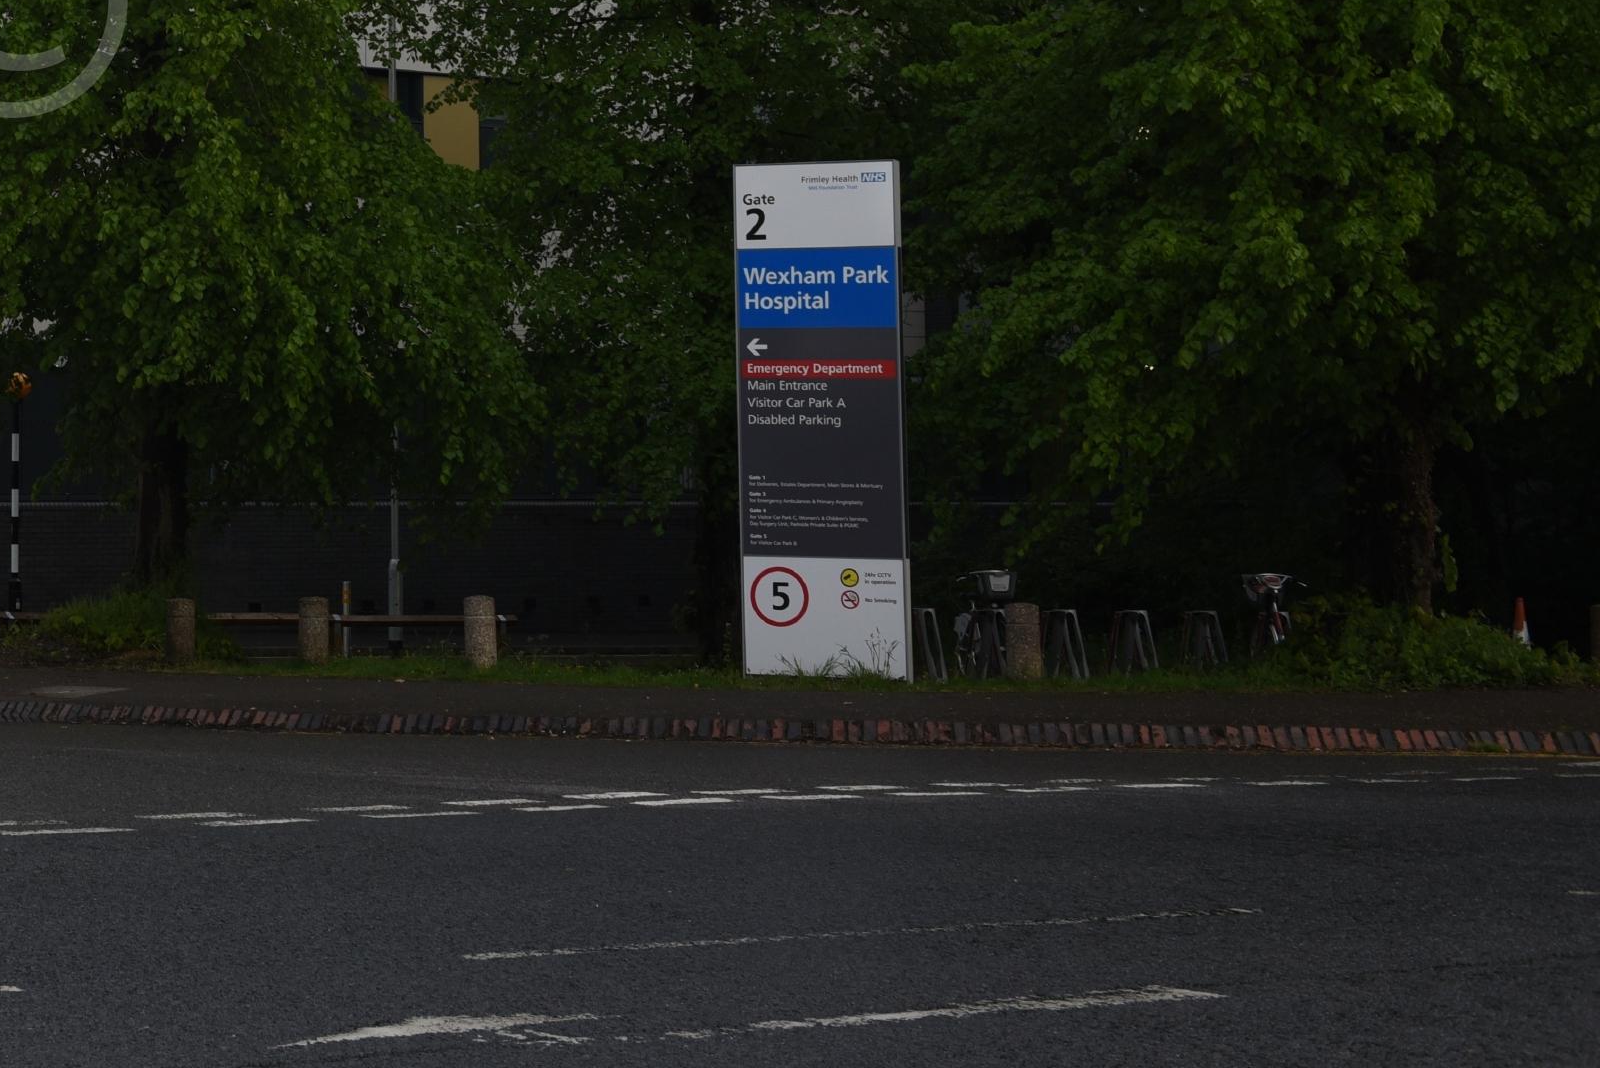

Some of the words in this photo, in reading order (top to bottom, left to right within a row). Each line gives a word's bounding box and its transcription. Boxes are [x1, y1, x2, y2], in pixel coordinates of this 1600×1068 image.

[801, 175, 830, 185] Frimley
[832, 174, 859, 183] Health
[861, 172, 886, 182] NHS
[742, 193, 775, 206] Gate
[745, 207, 767, 241] 2
[743, 265, 835, 285] Wexham
[842, 264, 889, 284] Park
[744, 290, 830, 314] Hospital
[747, 363, 809, 376] Emergency
[813, 363, 883, 376] Department
[747, 380, 776, 391] Main
[779, 380, 828, 391] Entrance
[747, 397, 783, 408] Visitor
[786, 397, 805, 408] Car
[808, 397, 833, 408] Park
[836, 398, 847, 408] A
[748, 413, 795, 425] Disabled
[799, 414, 842, 428] Parking
[772, 581, 790, 611] 5
